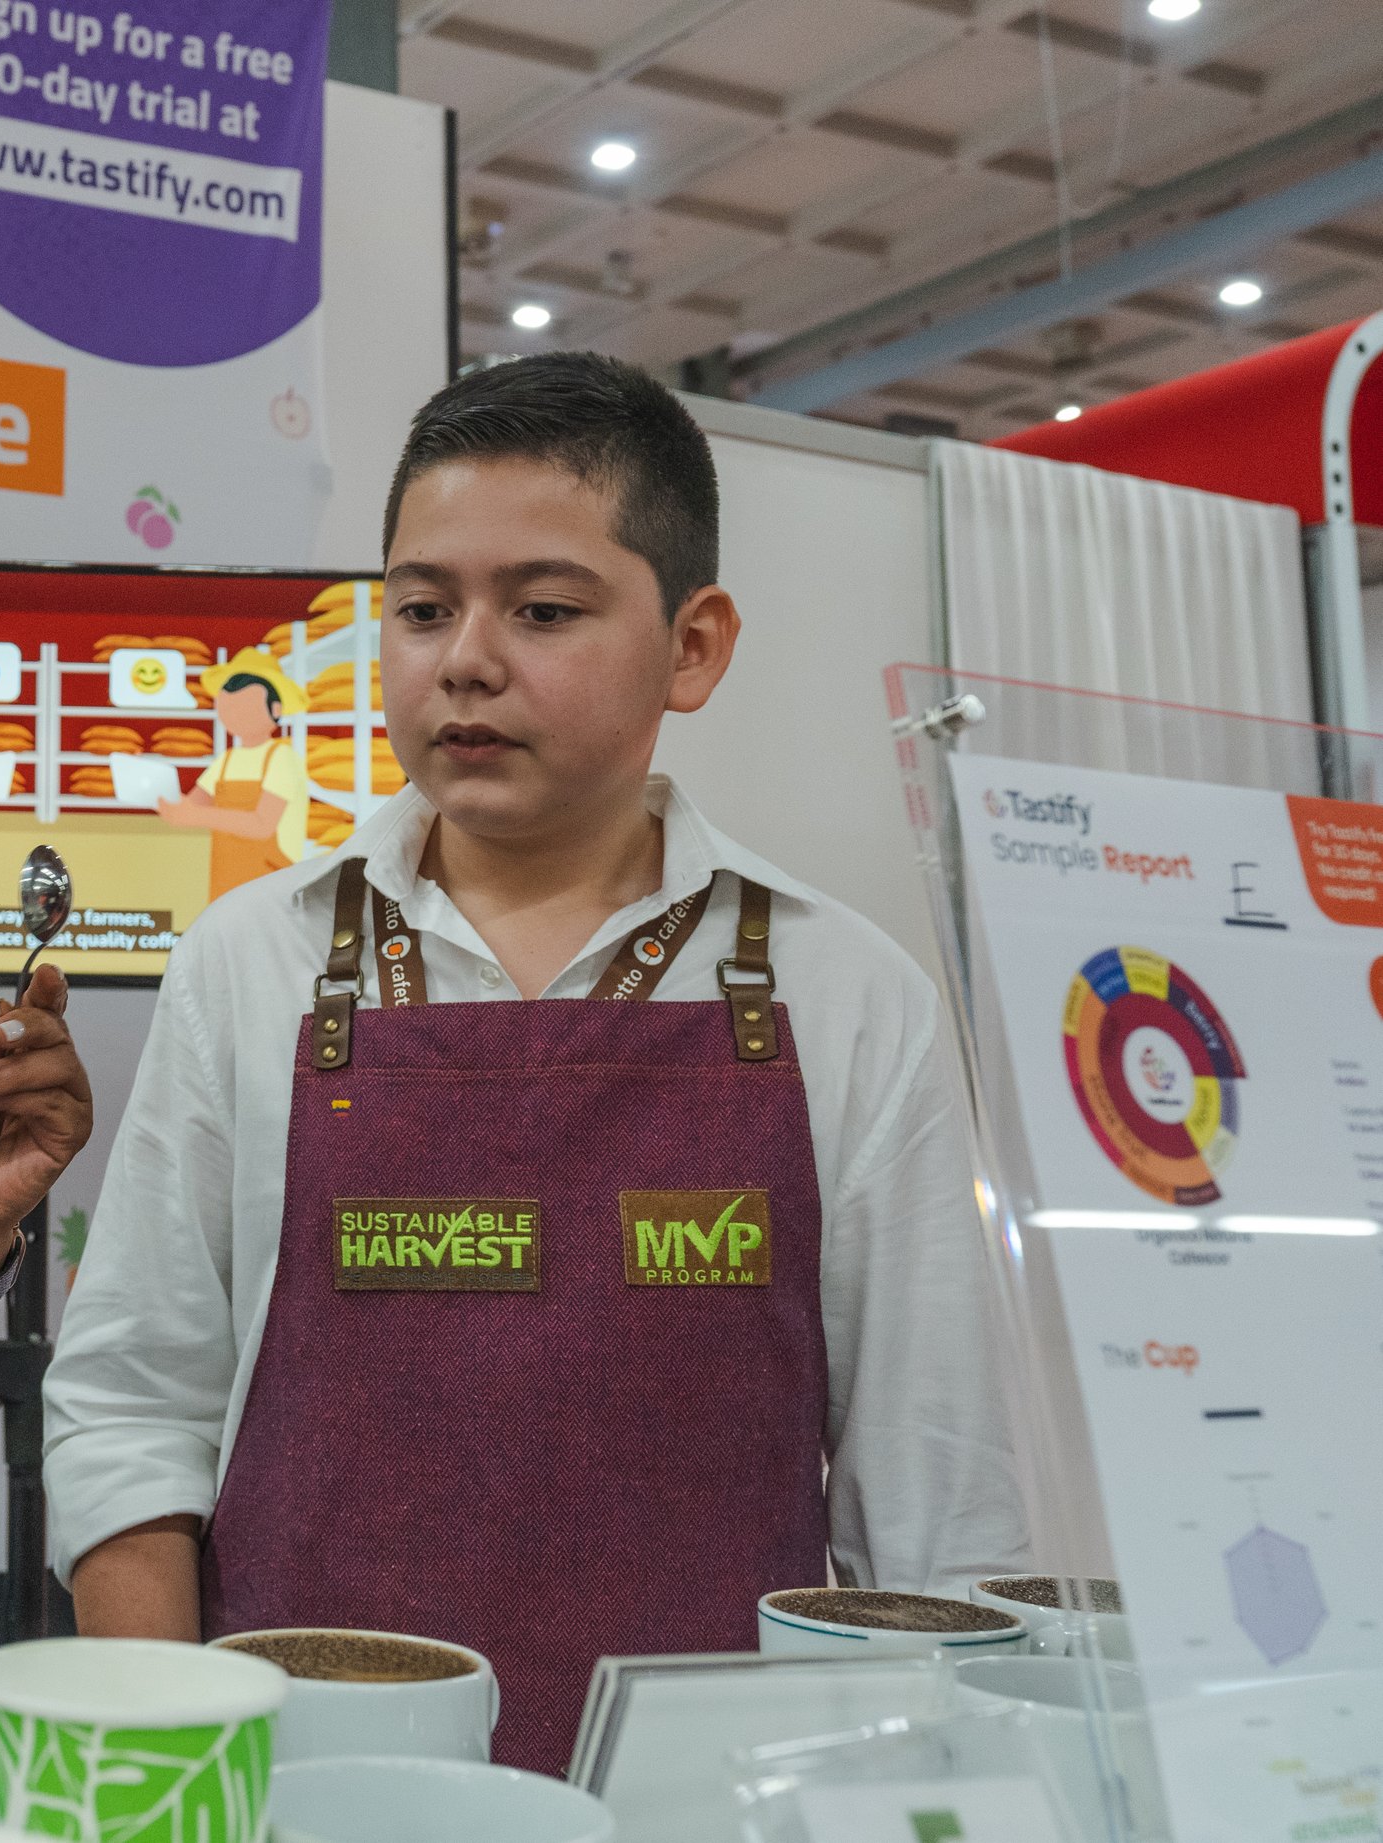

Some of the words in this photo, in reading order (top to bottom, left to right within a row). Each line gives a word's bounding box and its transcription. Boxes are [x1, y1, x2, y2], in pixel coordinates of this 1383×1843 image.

[49, 8, 103, 56] up
[113, 12, 174, 60] for
[180, 35, 205, 69] a
[215, 32, 294, 85] free
[128, 81, 211, 131] trial
[219, 102, 261, 142] at
[1004, 790, 1092, 836] Tastify
[991, 832, 1099, 876] Sample
[1101, 844, 1196, 885] Report
[25, 931, 75, 949] gat
[75, 930, 137, 951] quality
[83, 908, 156, 930] farmers,
[341, 1211, 534, 1233] SUSTAINABLE
[341, 1222, 532, 1268] HARVEST
[635, 1198, 763, 1268] MVP
[646, 1269, 754, 1284] PROGRAM
[1144, 1339, 1200, 1376] Cup
